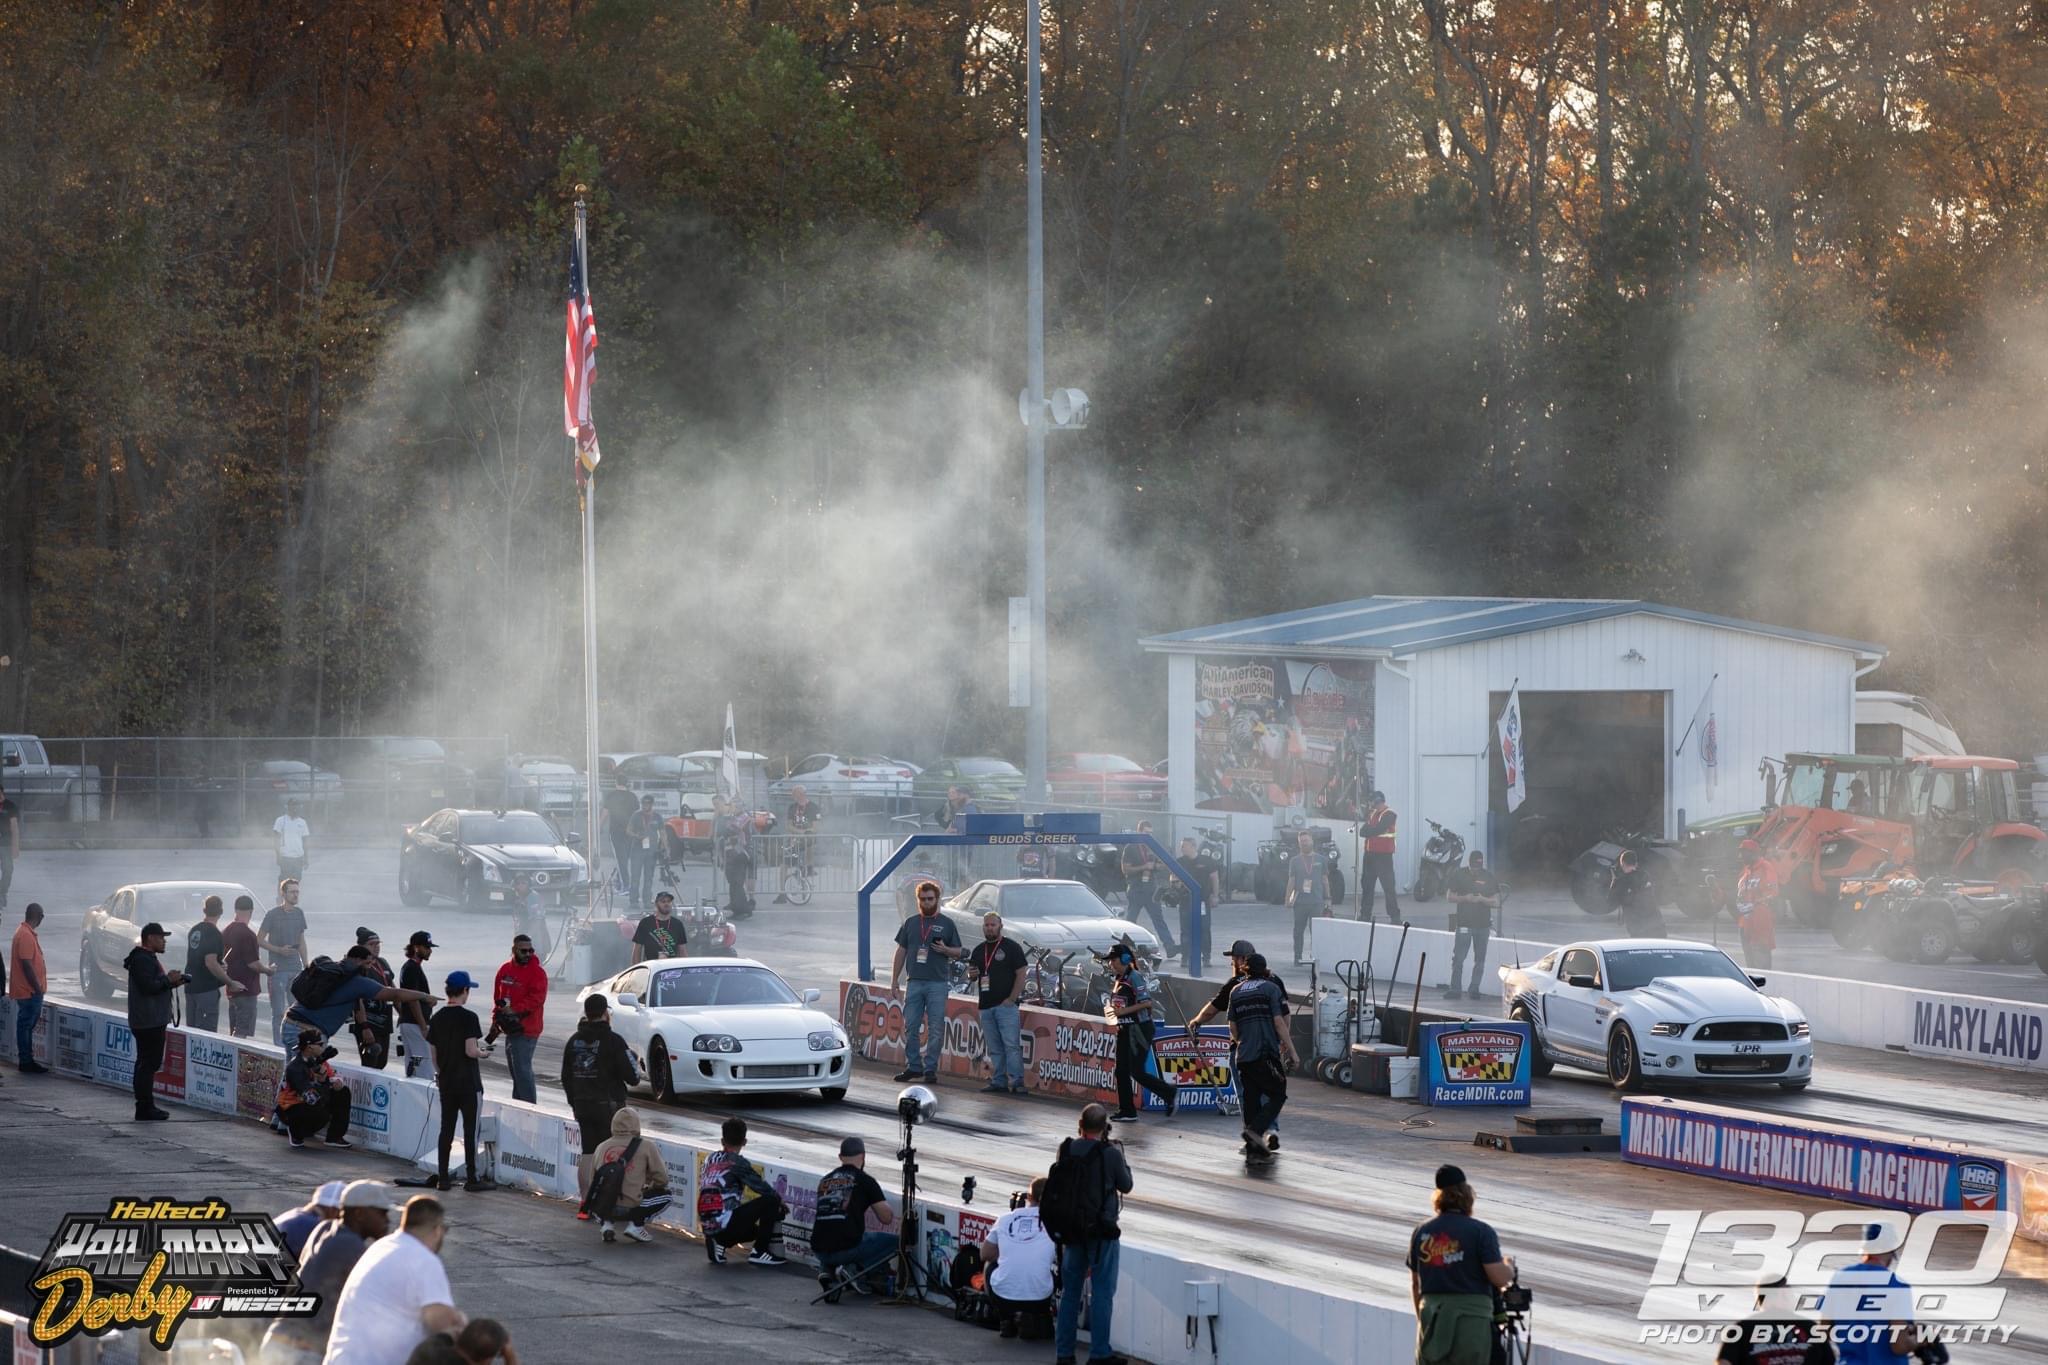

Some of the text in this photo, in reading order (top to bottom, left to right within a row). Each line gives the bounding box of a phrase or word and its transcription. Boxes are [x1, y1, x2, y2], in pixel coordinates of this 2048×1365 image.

[1202, 681, 1274, 699] HARLEY-DAVIDSON
[989, 834, 1077, 844] BUDDS CREEK
[106, 1024, 132, 1052] UPR
[1913, 1001, 2043, 1061] MARYLAND
[1056, 1024, 1117, 1060] 301-420-272
[1448, 1036, 1515, 1047] MARYLAND
[1735, 1044, 1761, 1053] UPR
[1436, 1087, 1524, 1101] RaceMDIR.com
[1628, 1110, 1950, 1208] MARYLAND INTERNATIONAL RACEWAY
[1962, 1167, 1997, 1186] IHRA
